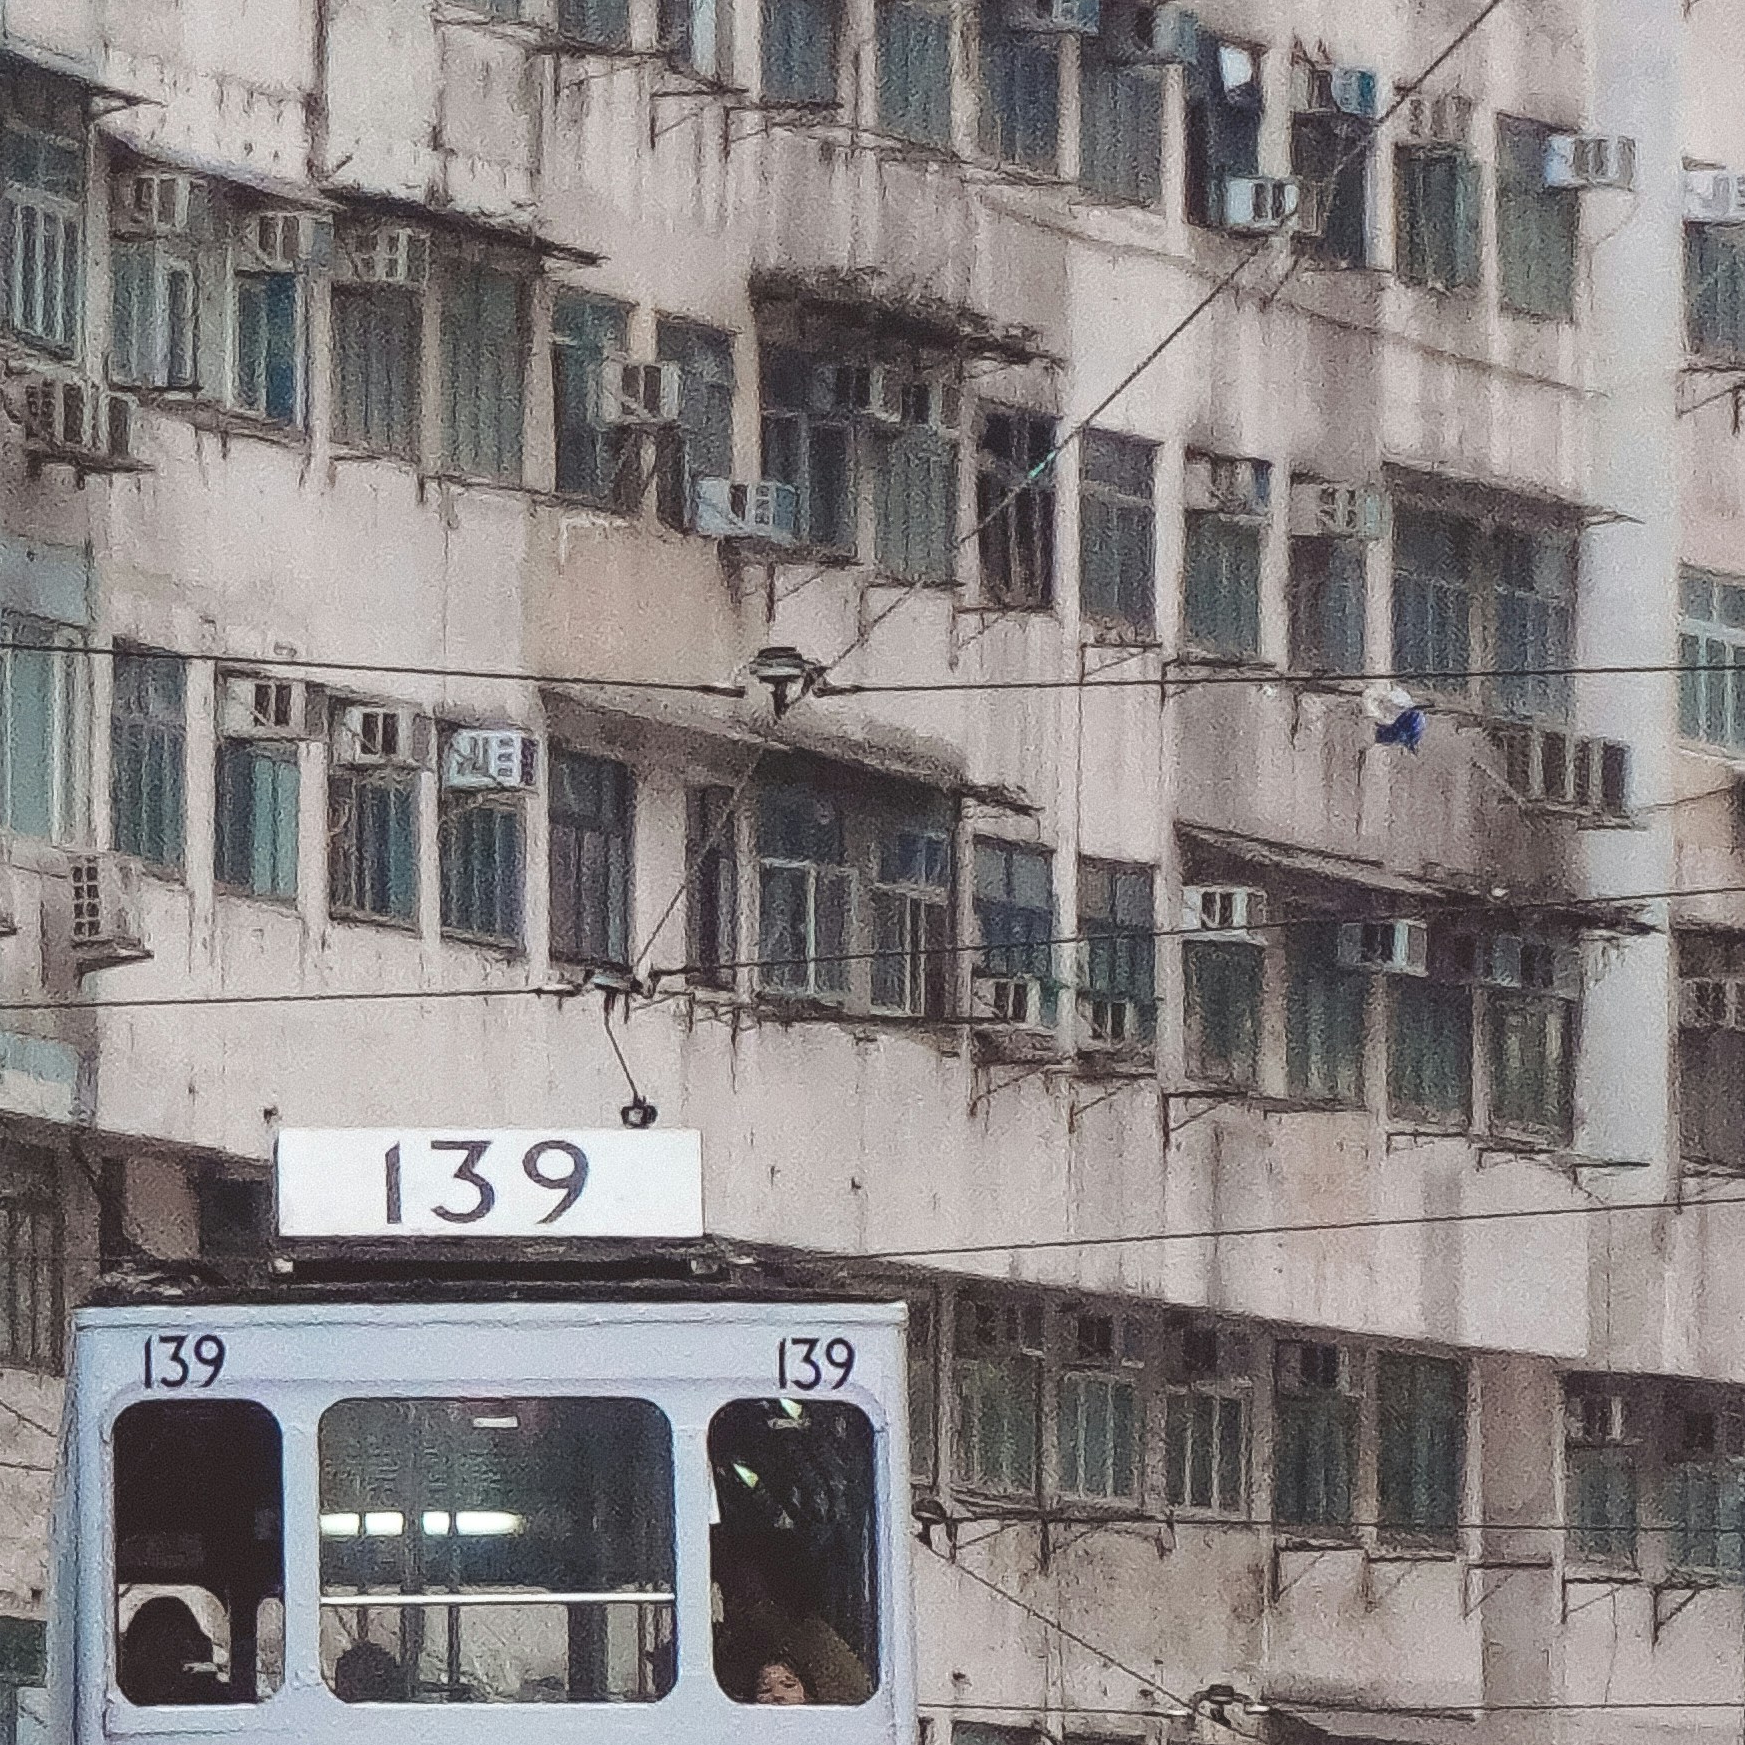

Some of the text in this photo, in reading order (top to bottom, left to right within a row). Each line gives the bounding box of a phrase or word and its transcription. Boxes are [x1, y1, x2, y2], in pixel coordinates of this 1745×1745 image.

[384, 1139, 590, 1225] 139
[141, 1334, 226, 1390] 139
[777, 1337, 856, 1391] 139
